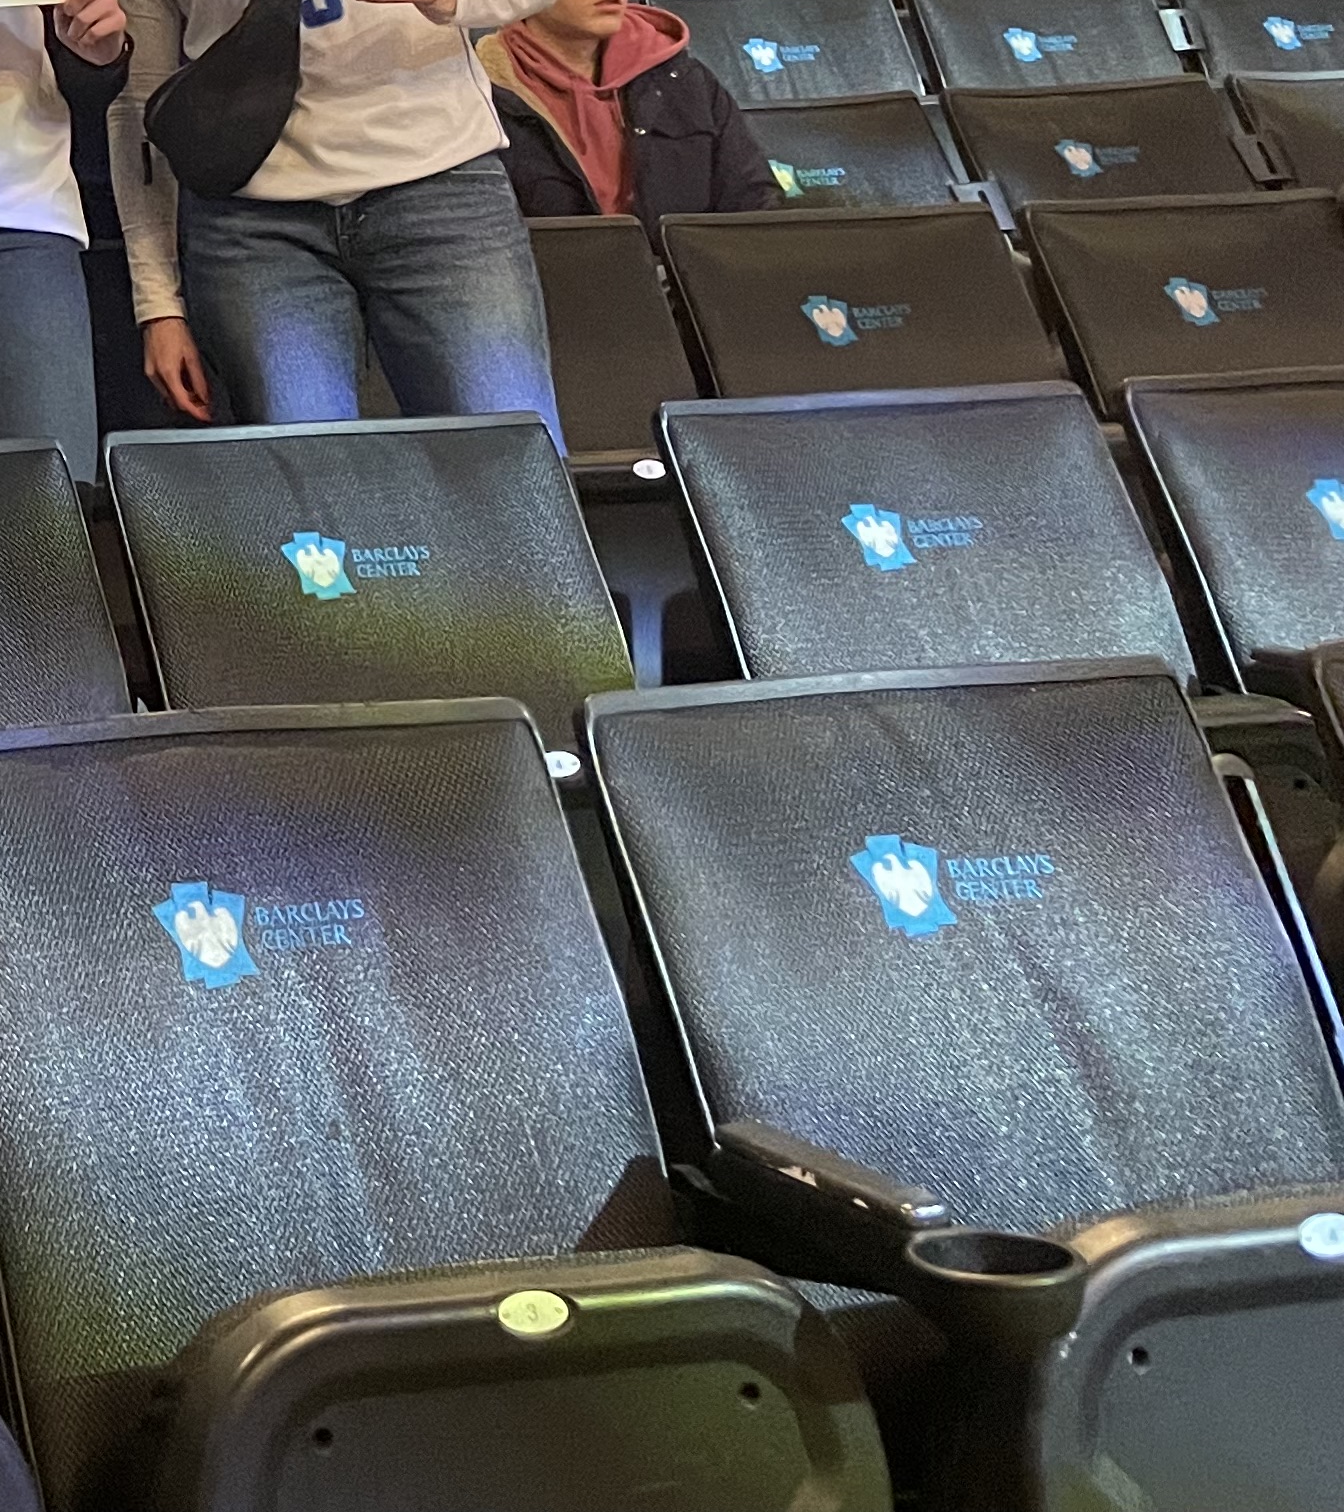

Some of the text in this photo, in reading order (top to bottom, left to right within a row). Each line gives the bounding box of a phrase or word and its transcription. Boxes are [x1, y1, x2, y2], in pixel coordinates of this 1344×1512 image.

[351, 545, 430, 563] BARCLAYS
[356, 561, 421, 578] CENTER
[946, 854, 1055, 880] BARCLAYS
[955, 878, 1043, 901] CENTER
[254, 898, 365, 927] BARCLAYS
[261, 924, 352, 951] CENTER
